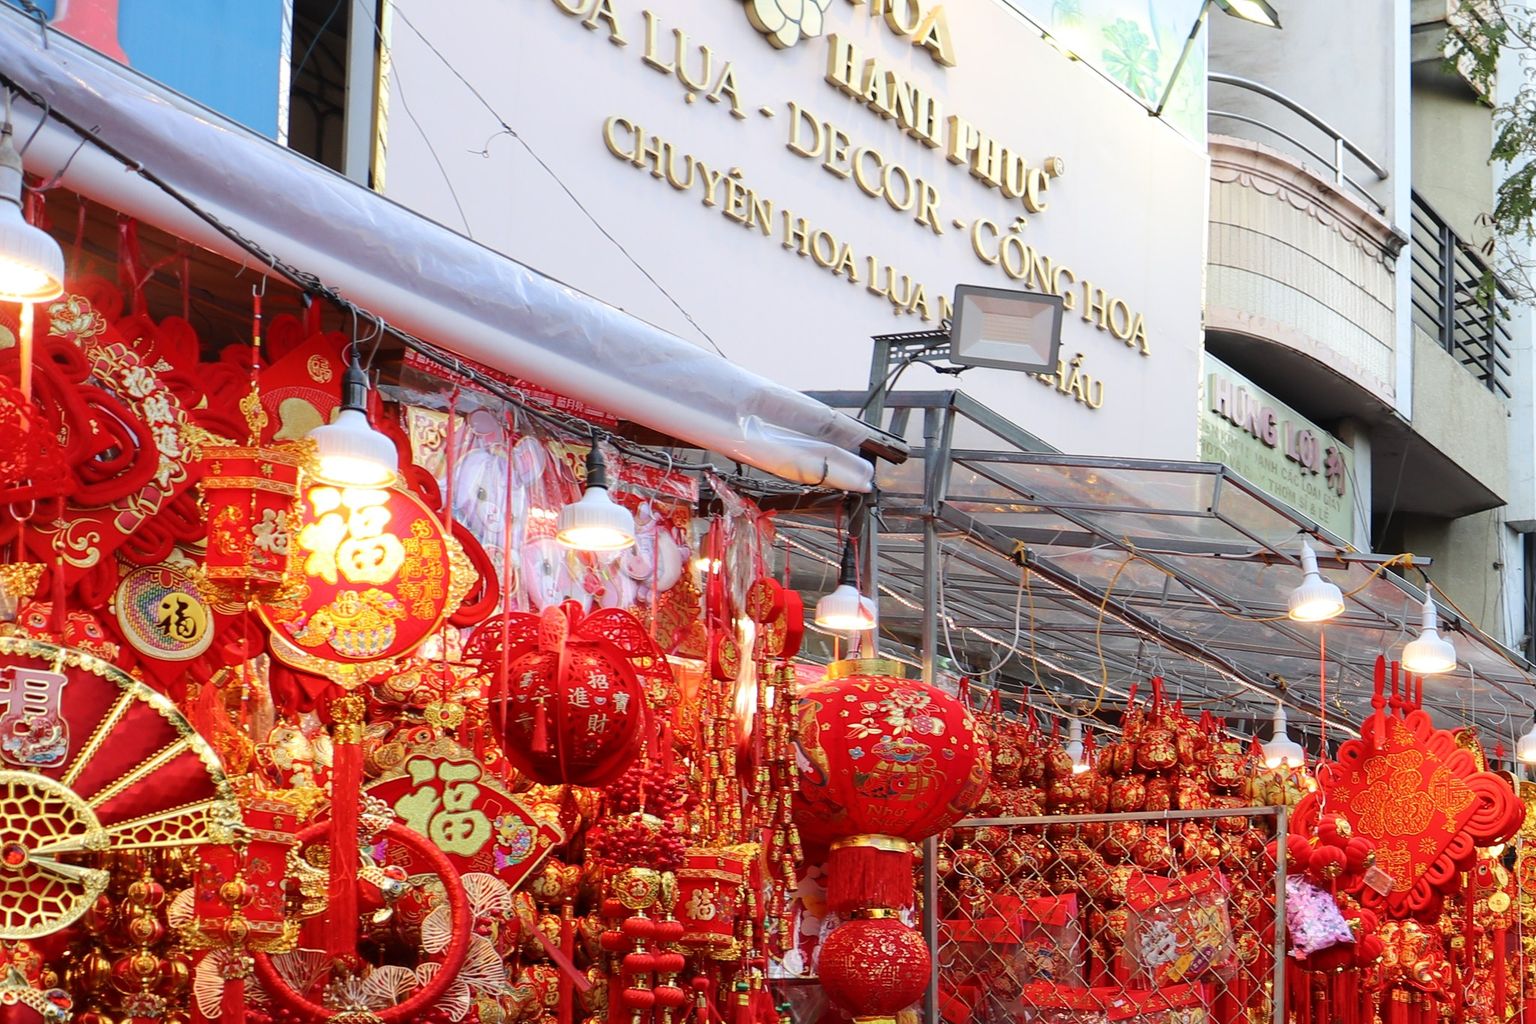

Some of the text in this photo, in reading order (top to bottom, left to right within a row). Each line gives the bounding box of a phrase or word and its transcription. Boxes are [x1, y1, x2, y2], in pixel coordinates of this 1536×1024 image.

[641, 9, 747, 120] LỤA
[785, 101, 944, 236] DECOR
[1081, 280, 1152, 357] HOA
[603, 116, 776, 237] CHUYÊN
[782, 209, 861, 284] HOA
[866, 255, 932, 322] LỤA
[1027, 352, 1105, 410] HẨU
[296, 485, 407, 586] 福
[156, 596, 197, 639] 福
[567, 686, 591, 708] 進
[587, 670, 609, 690] 招
[585, 713, 610, 734] 財
[394, 759, 492, 857] 福
[684, 888, 717, 921] 福
